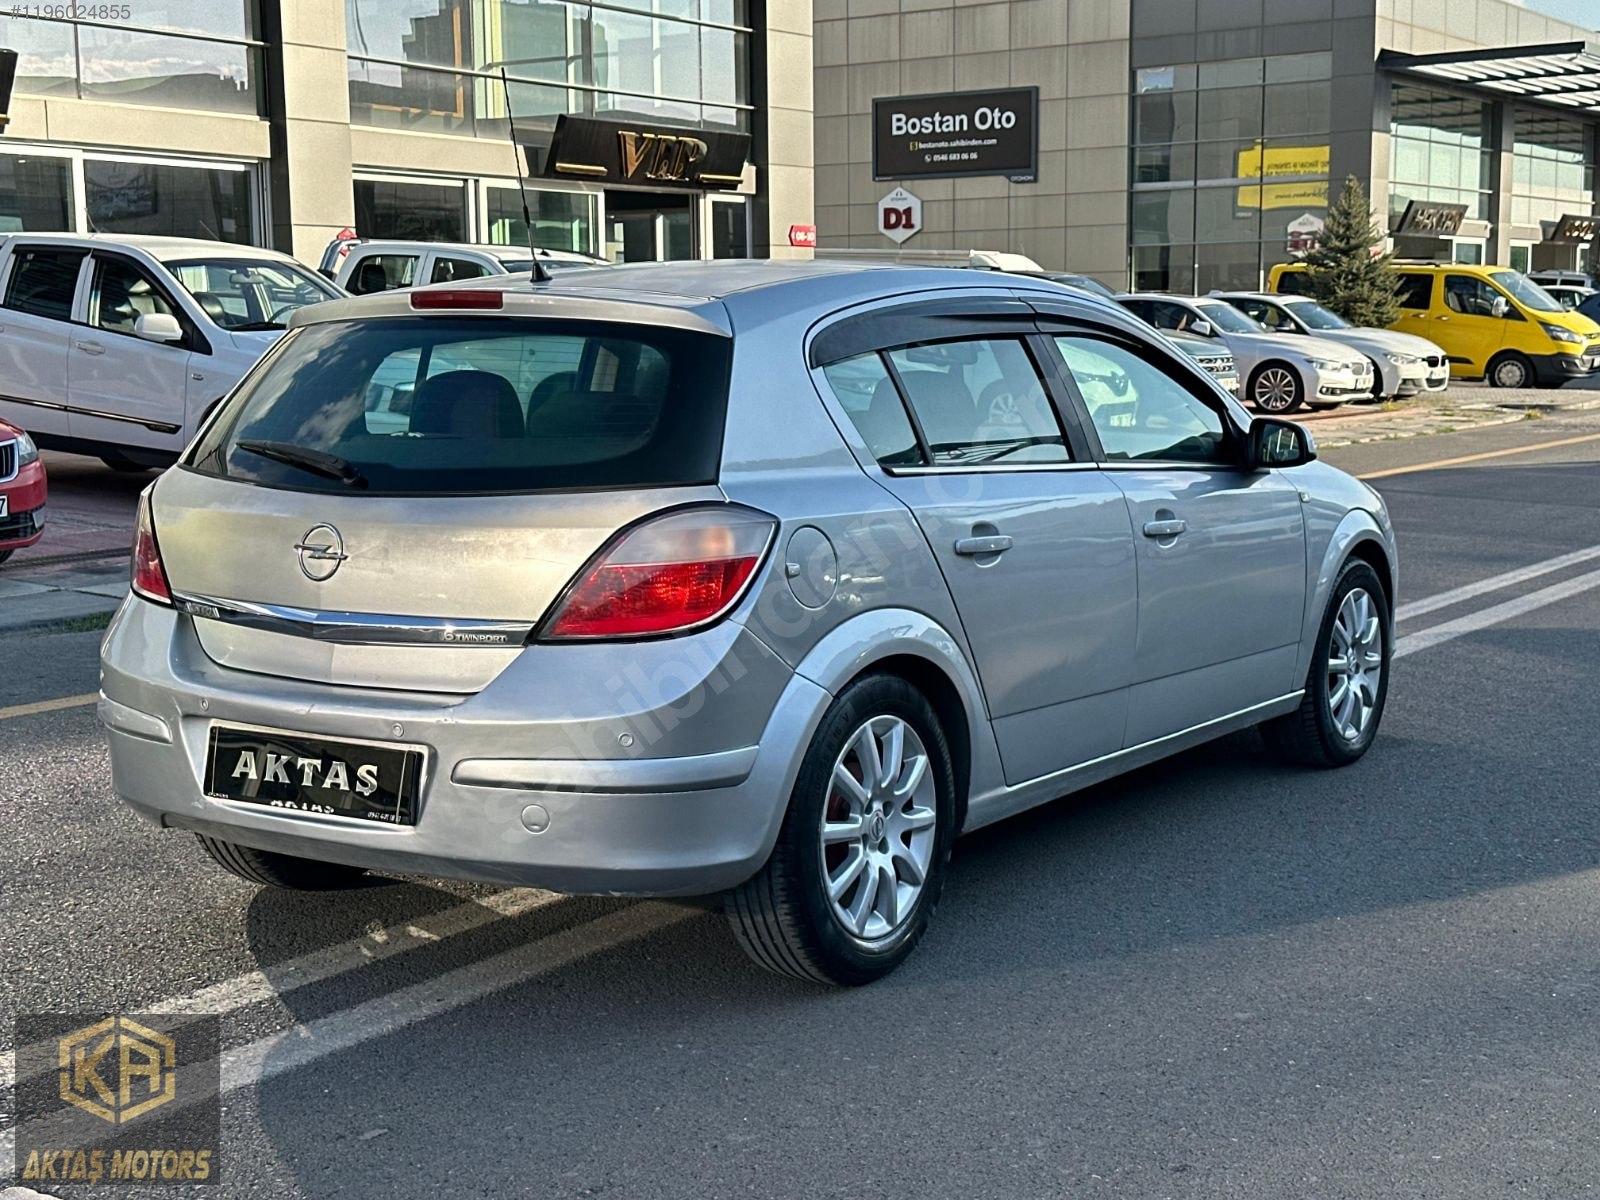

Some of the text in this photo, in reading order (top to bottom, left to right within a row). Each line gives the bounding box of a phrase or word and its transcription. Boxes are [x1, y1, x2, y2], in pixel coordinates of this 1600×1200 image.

[891, 107, 1016, 136] Bostan Oto
[618, 130, 708, 180] VIP
[883, 206, 915, 230] D1
[231, 750, 378, 797] AKTAŞ
